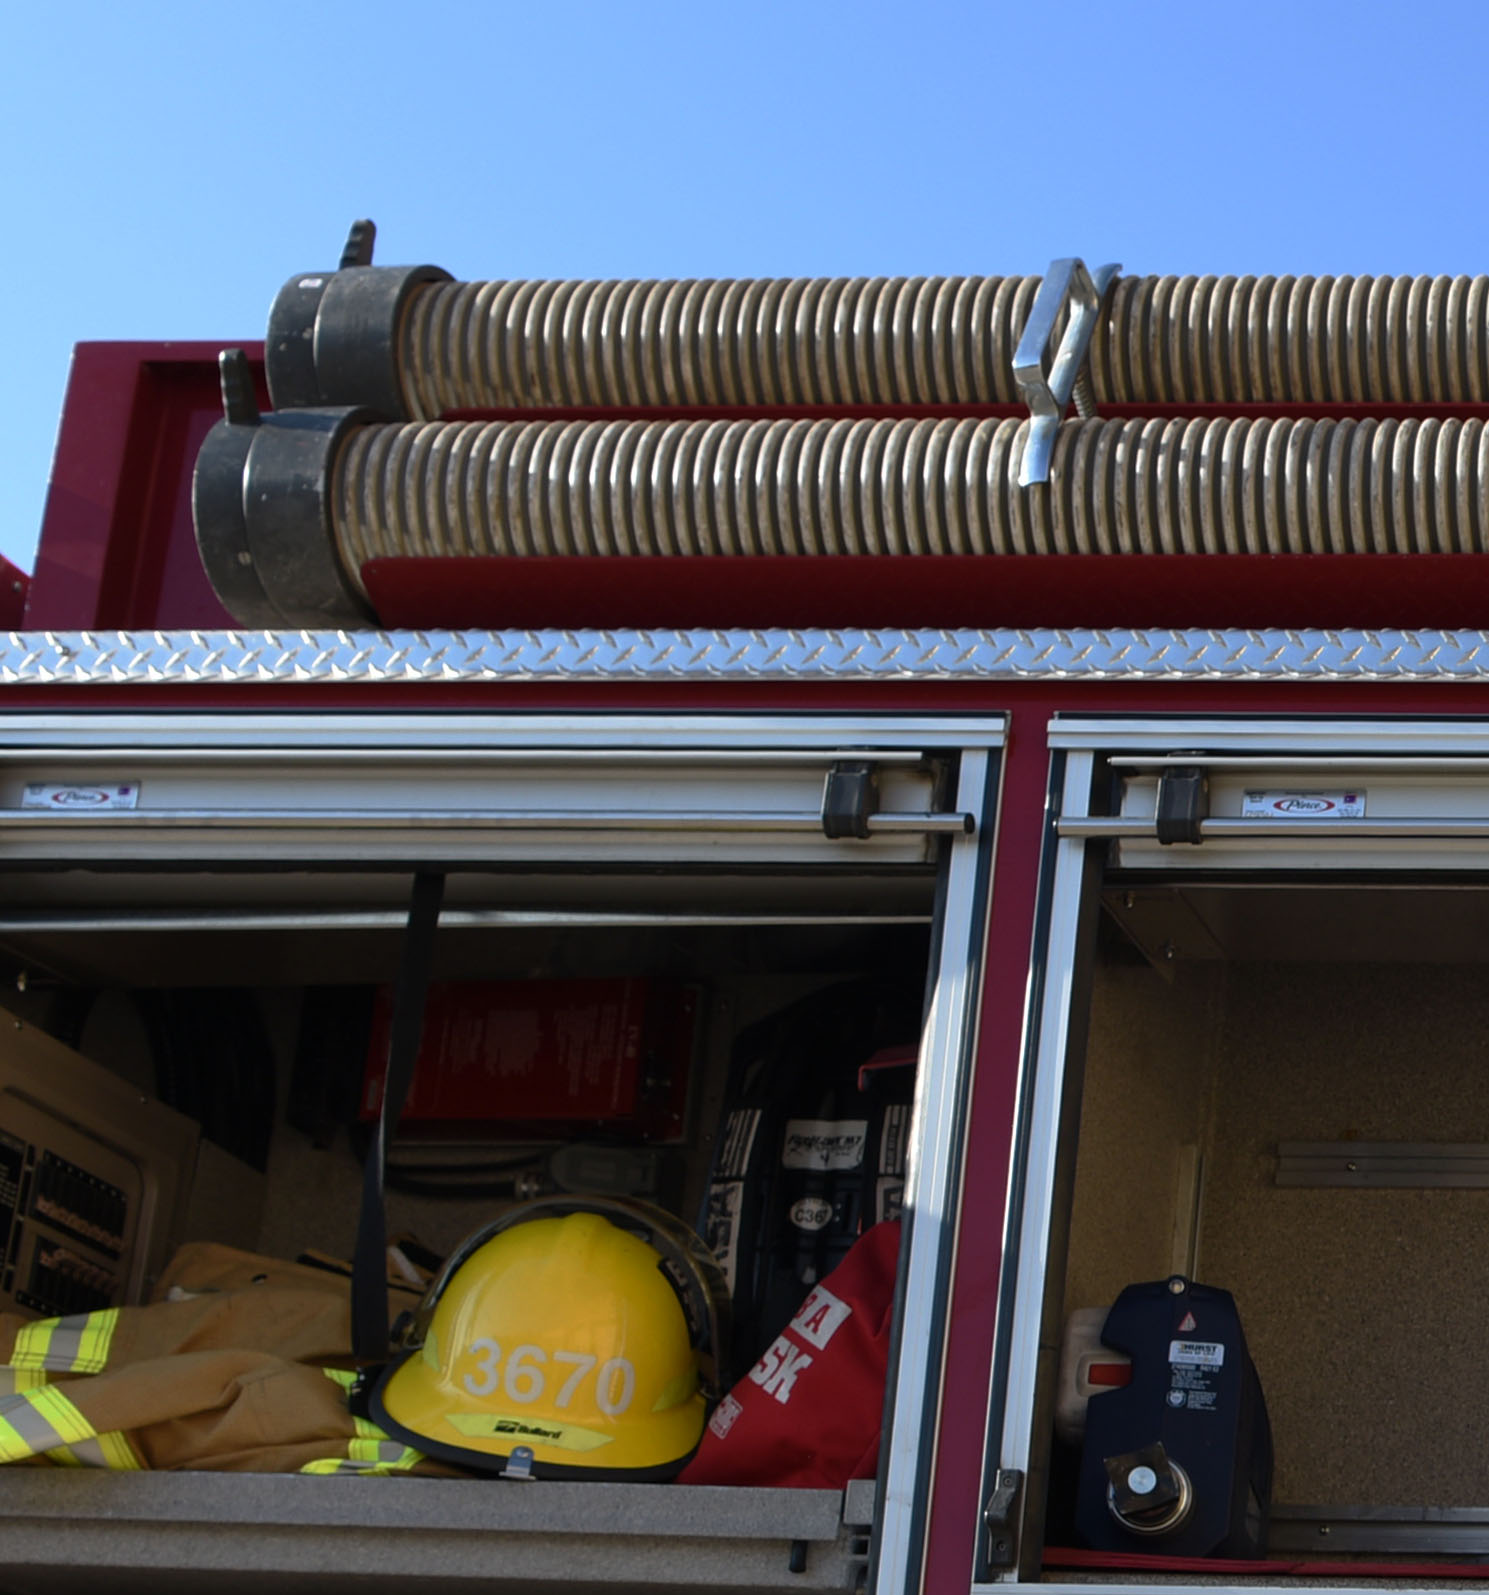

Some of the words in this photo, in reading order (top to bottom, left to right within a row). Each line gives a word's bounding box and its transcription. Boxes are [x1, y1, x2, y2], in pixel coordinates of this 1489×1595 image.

[1285, 799, 1322, 812] Pierce
[463, 1337, 635, 1415] 3670
[517, 1422, 562, 1440] Bullard
